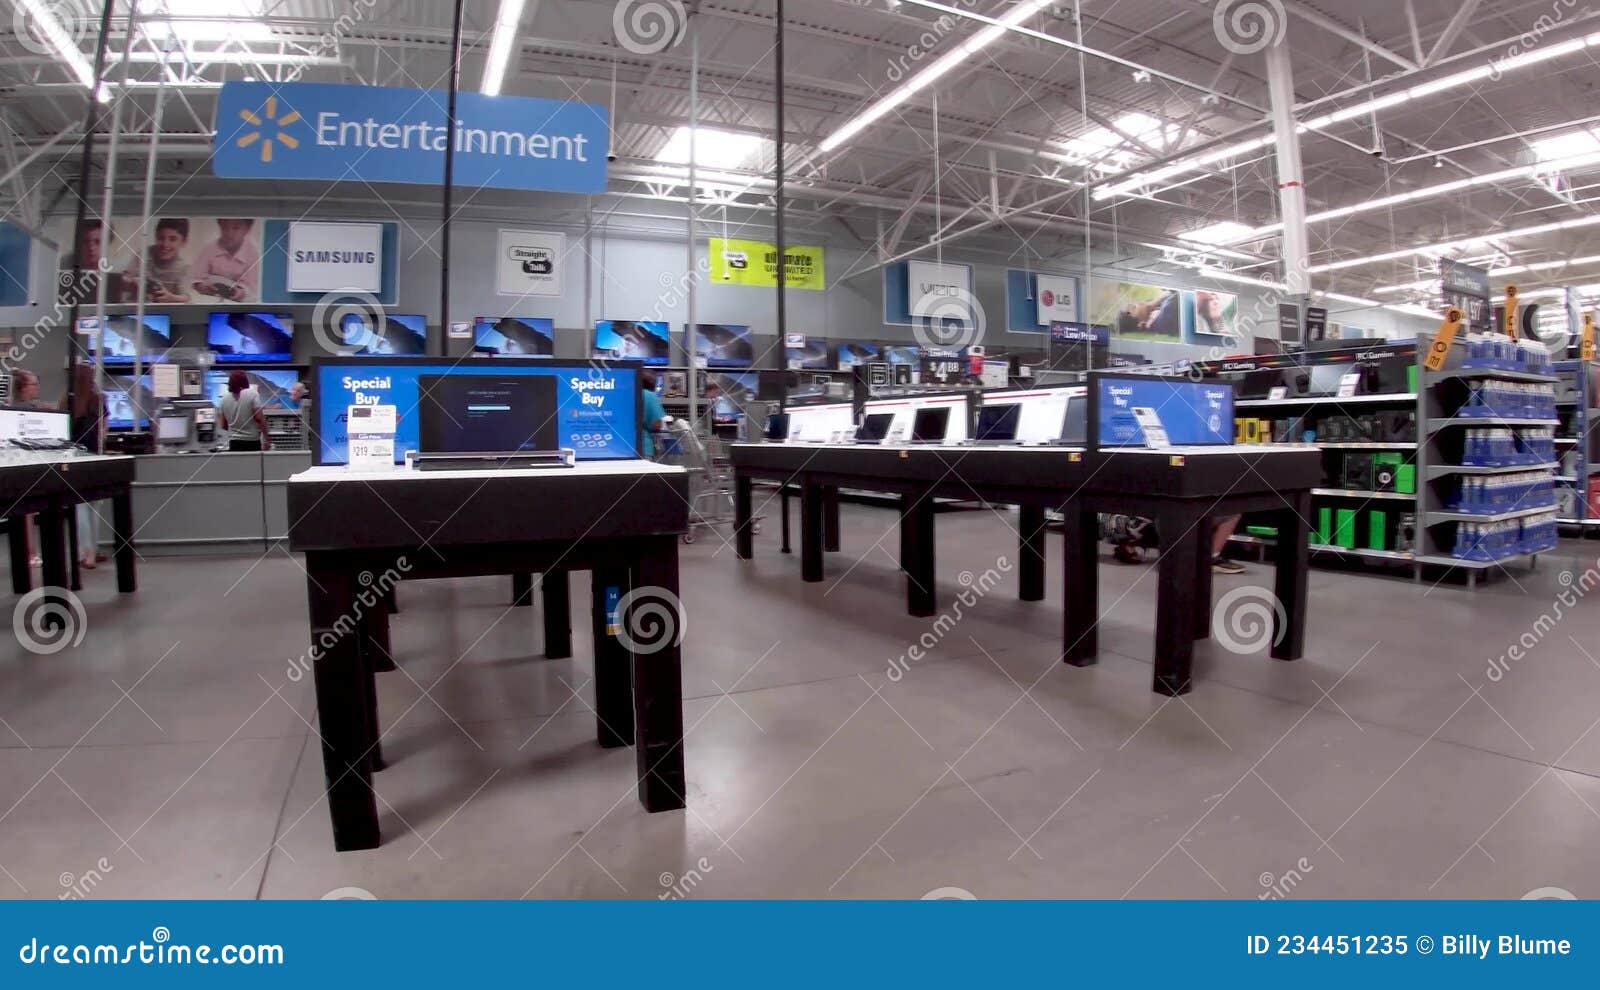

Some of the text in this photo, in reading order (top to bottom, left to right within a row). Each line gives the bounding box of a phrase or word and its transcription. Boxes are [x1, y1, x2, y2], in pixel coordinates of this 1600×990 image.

[316, 111, 588, 162] Entertainment
[294, 250, 376, 264] SAMSUNG
[514, 249, 548, 259] Straight
[920, 283, 960, 297] VIZIO
[1057, 295, 1071, 305] LG
[1065, 331, 1080, 340] Low
[343, 376, 391, 393] Special
[571, 377, 615, 393] Special
[1109, 386, 1132, 396] Special
[355, 392, 380, 405] Buy
[582, 392, 605, 407] Buy
